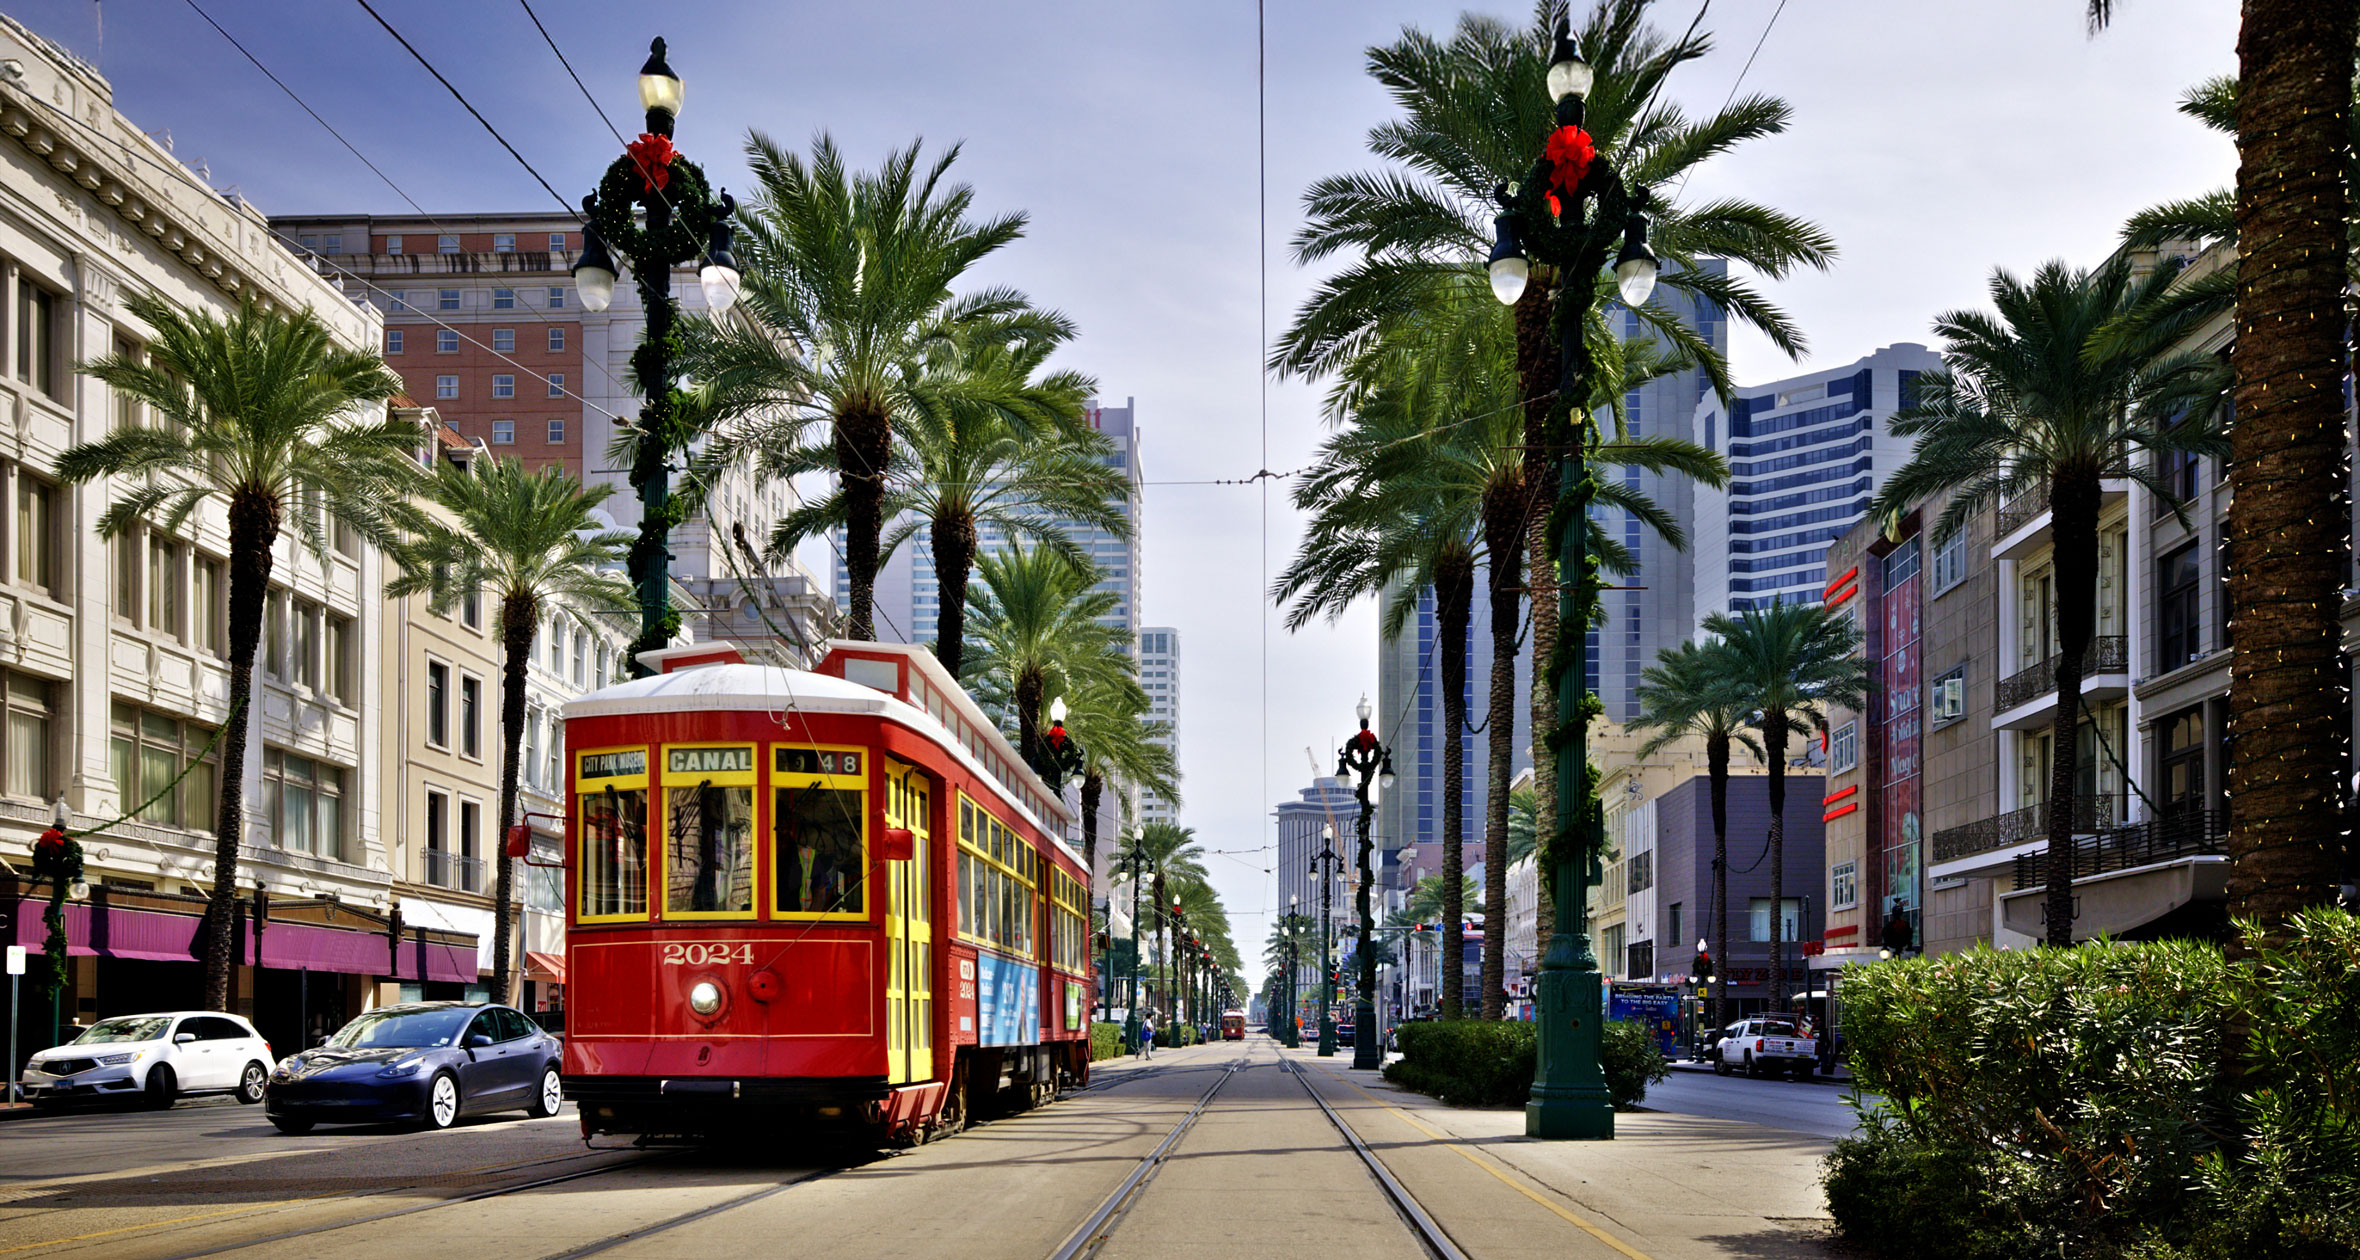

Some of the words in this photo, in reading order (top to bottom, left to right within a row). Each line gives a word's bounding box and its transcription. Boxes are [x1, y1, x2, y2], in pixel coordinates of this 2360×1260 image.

[584, 756, 599, 773] CITY
[670, 752, 752, 771] CANAL
[1891, 754, 1918, 778] Magc
[663, 944, 755, 965] 2024
[960, 981, 975, 1000] 2024
